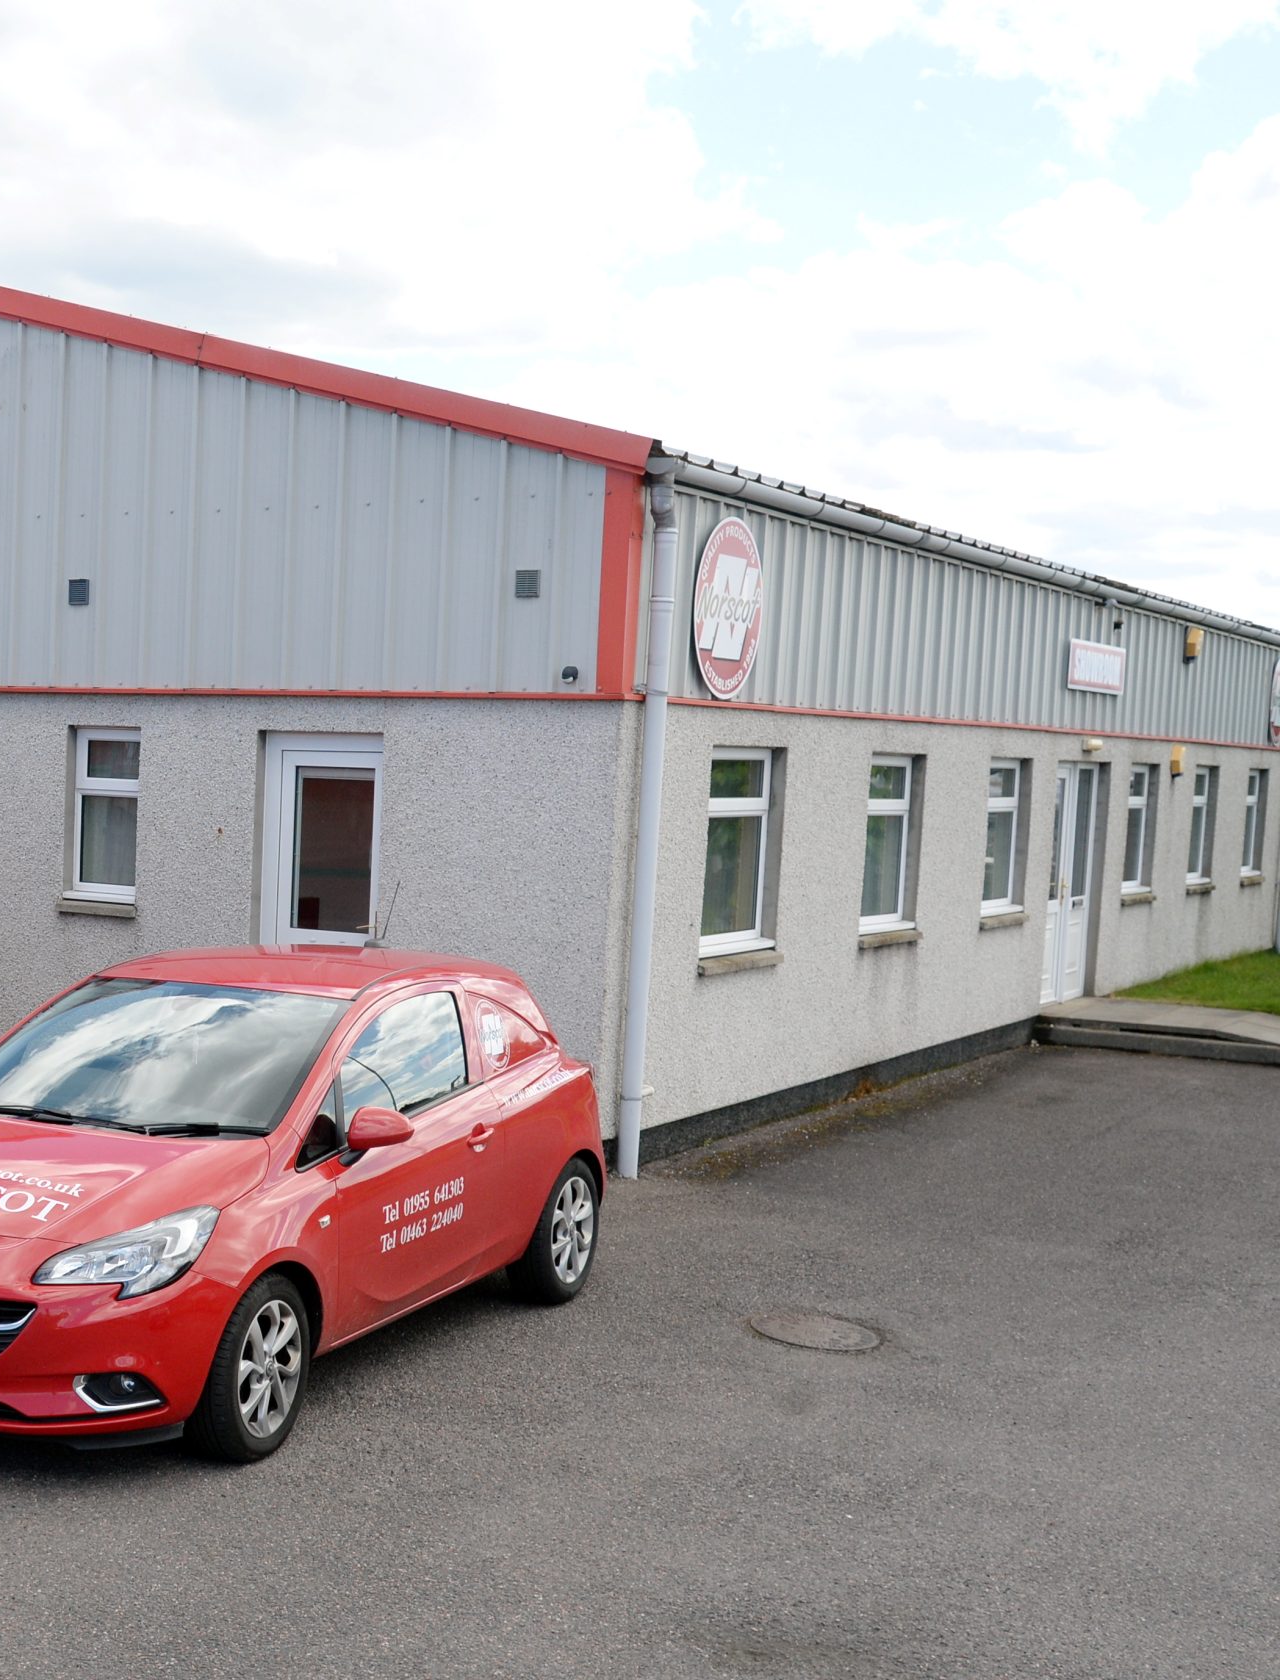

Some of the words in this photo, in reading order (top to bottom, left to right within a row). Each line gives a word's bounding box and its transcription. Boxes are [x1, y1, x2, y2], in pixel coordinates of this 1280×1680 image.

[700, 531, 725, 581] QUALITY
[725, 524, 757, 564] PRODUCTS
[696, 585, 761, 626] Norscot
[703, 659, 744, 692] ESTABLISHED
[382, 1200, 400, 1225] Tel
[403, 1189, 430, 1217] 01955
[434, 1176, 465, 1204] 641303
[380, 1229, 397, 1254] Tel
[400, 1217, 427, 1245] 01463
[430, 1202, 464, 1232] 224040
